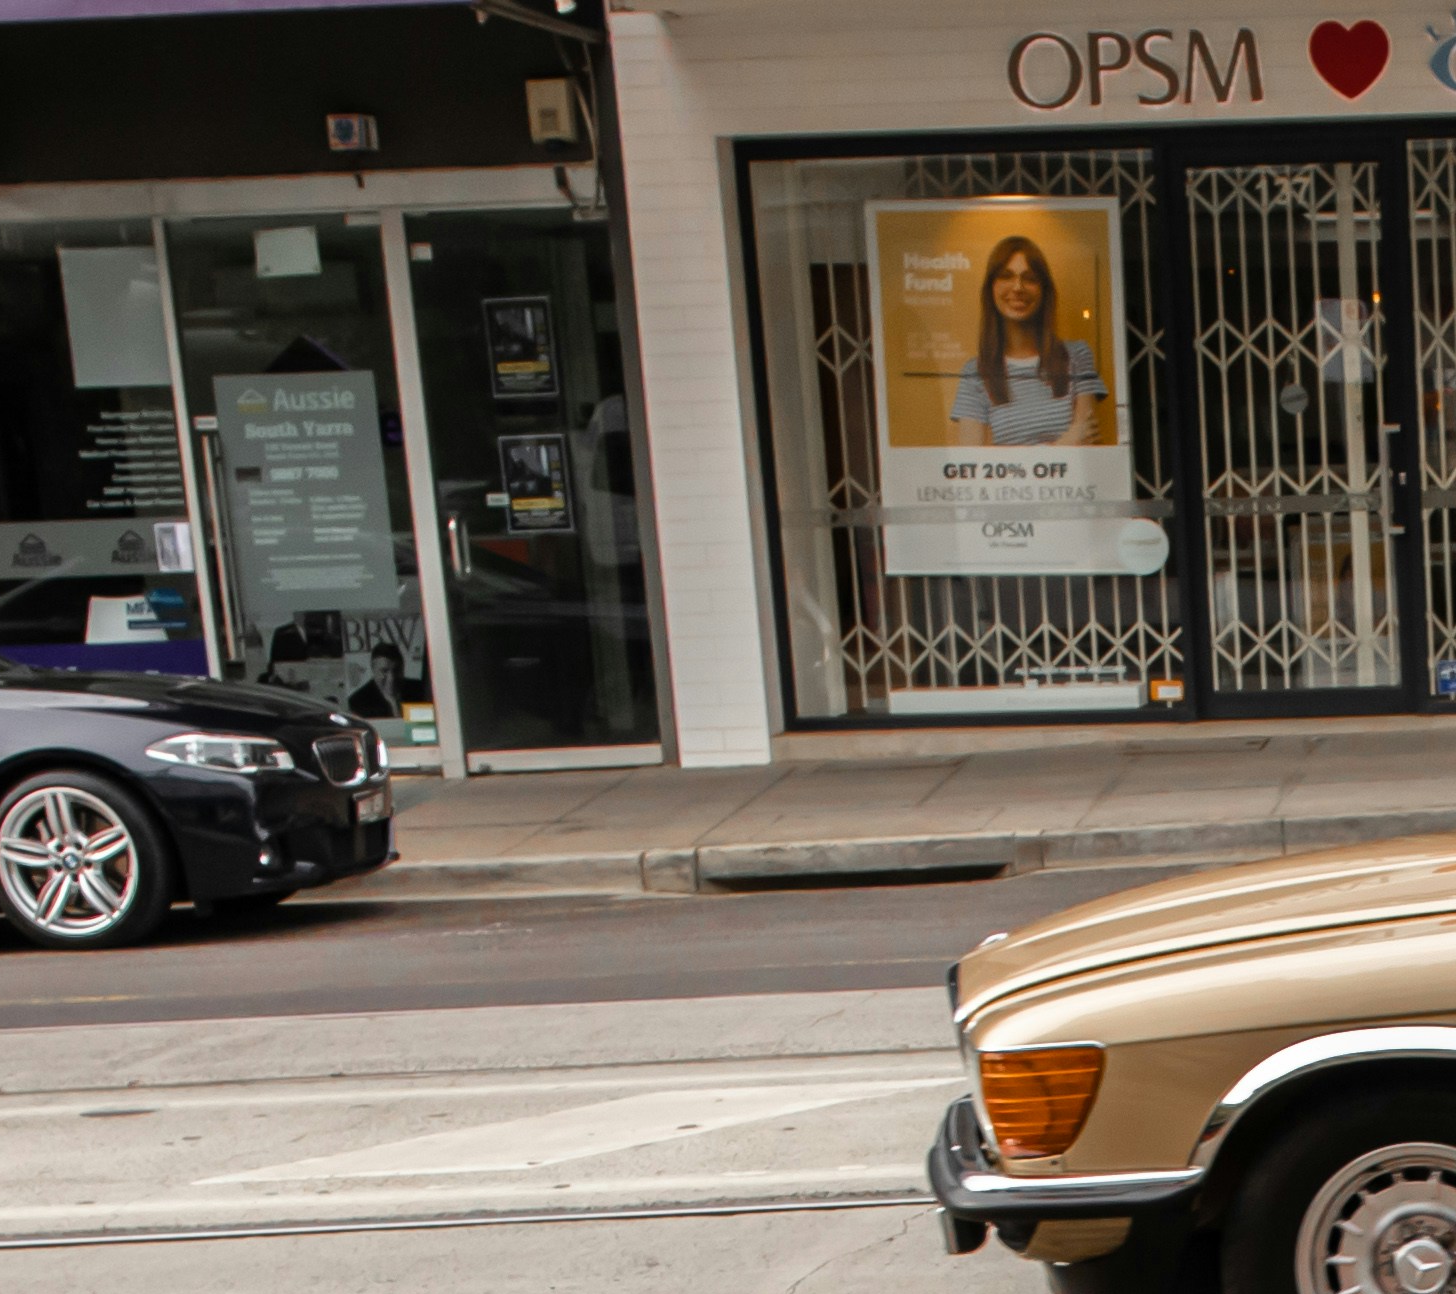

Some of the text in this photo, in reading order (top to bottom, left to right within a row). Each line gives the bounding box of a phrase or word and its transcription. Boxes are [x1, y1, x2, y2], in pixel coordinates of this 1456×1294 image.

[1007, 27, 1265, 110] OPSM
[272, 387, 356, 412] Aussie
[943, 462, 1068, 479] GET 20% OFF
[917, 486, 975, 502] LENSES
[996, 486, 1034, 501] LENS
[1039, 484, 1097, 500] EXTRAS
[981, 522, 1035, 539] OPSM
